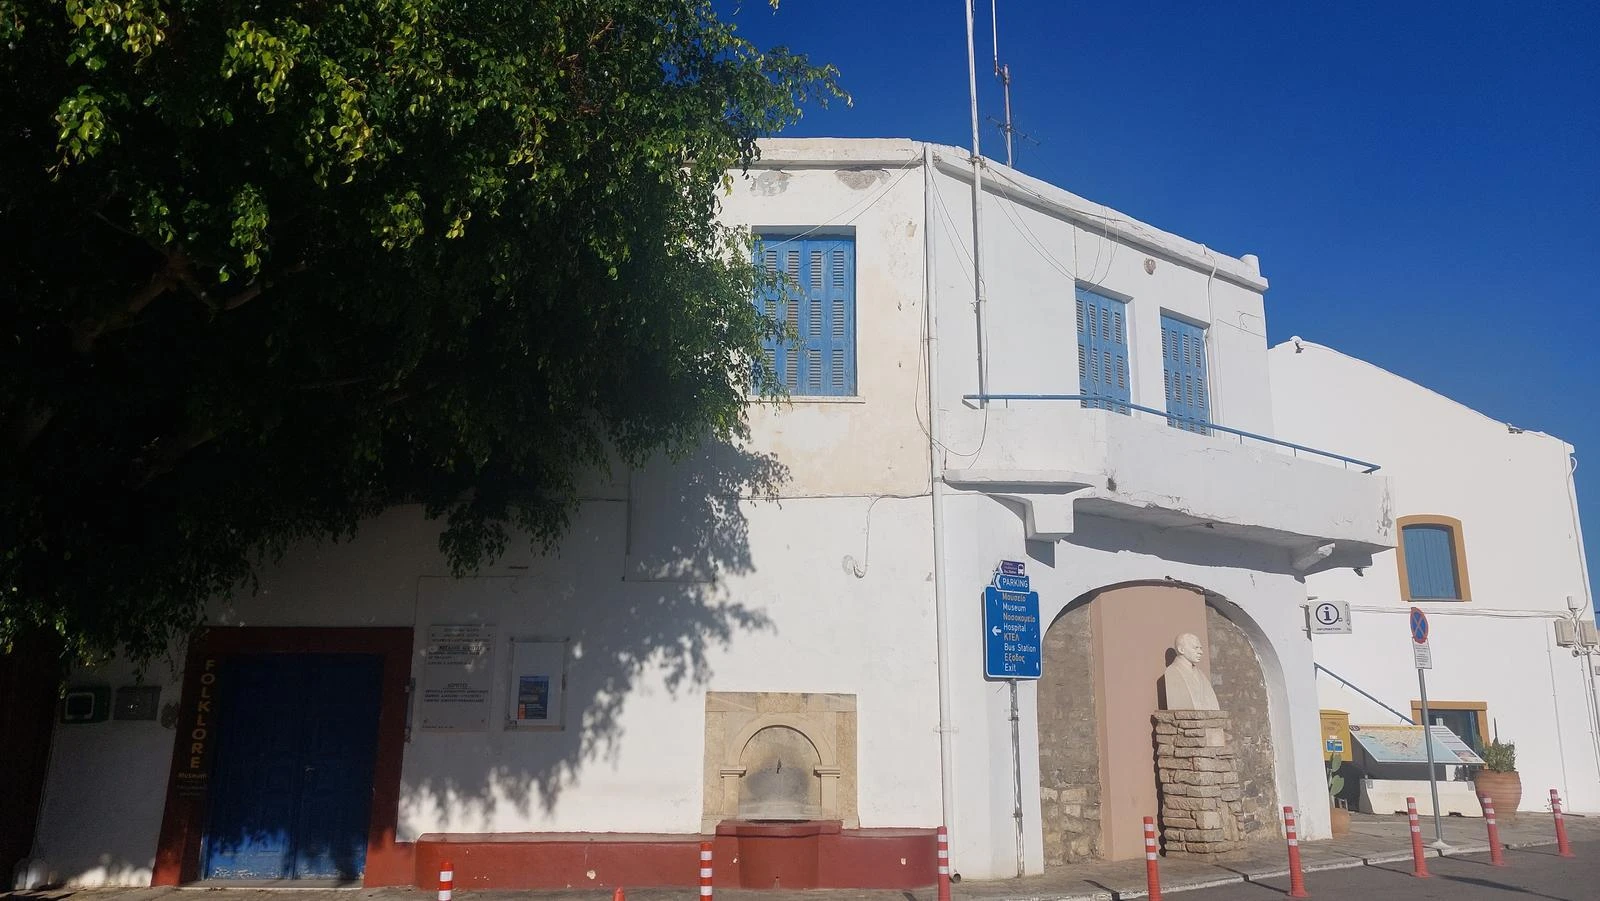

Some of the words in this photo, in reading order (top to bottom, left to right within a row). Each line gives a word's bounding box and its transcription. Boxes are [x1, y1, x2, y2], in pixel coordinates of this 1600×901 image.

[1002, 577, 1029, 588] PARKING
[1002, 602, 1026, 612] Museum
[1003, 622, 1027, 633] Hospital
[1003, 632, 1020, 641] ΚΤΕΛ
[1004, 642, 1016, 652] Bus
[1017, 643, 1036, 653] Station
[1004, 663, 1017, 672] Exit
[190, 659, 216, 769] FOLKLORE
